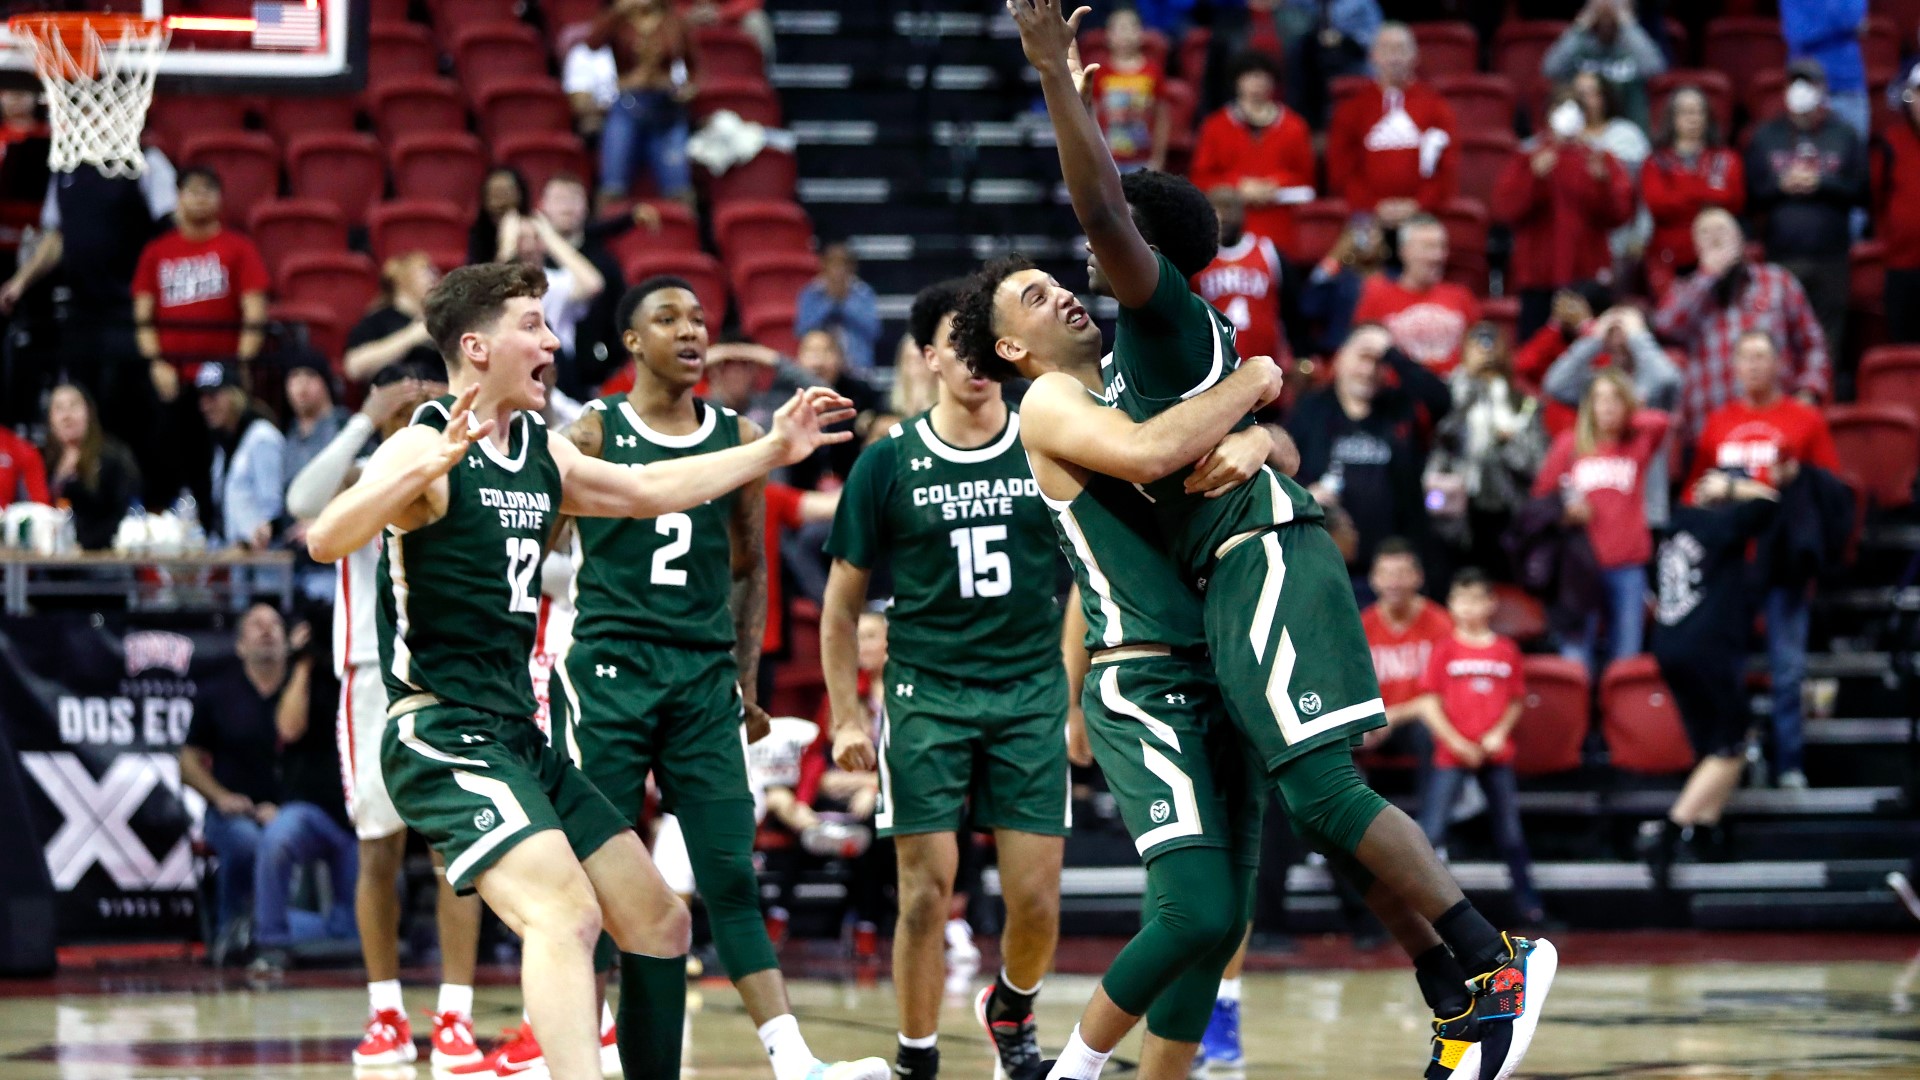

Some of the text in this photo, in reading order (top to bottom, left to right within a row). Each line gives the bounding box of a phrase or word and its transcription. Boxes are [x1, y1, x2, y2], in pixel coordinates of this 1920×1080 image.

[479, 487, 551, 512] COLORADO
[912, 478, 1040, 507] COLORADO
[941, 497, 1014, 521] STATE
[498, 508, 544, 530] STATE
[650, 512, 693, 587] 2
[949, 524, 1012, 599] 15
[505, 537, 540, 613] 12
[58, 696, 135, 745] DOS
